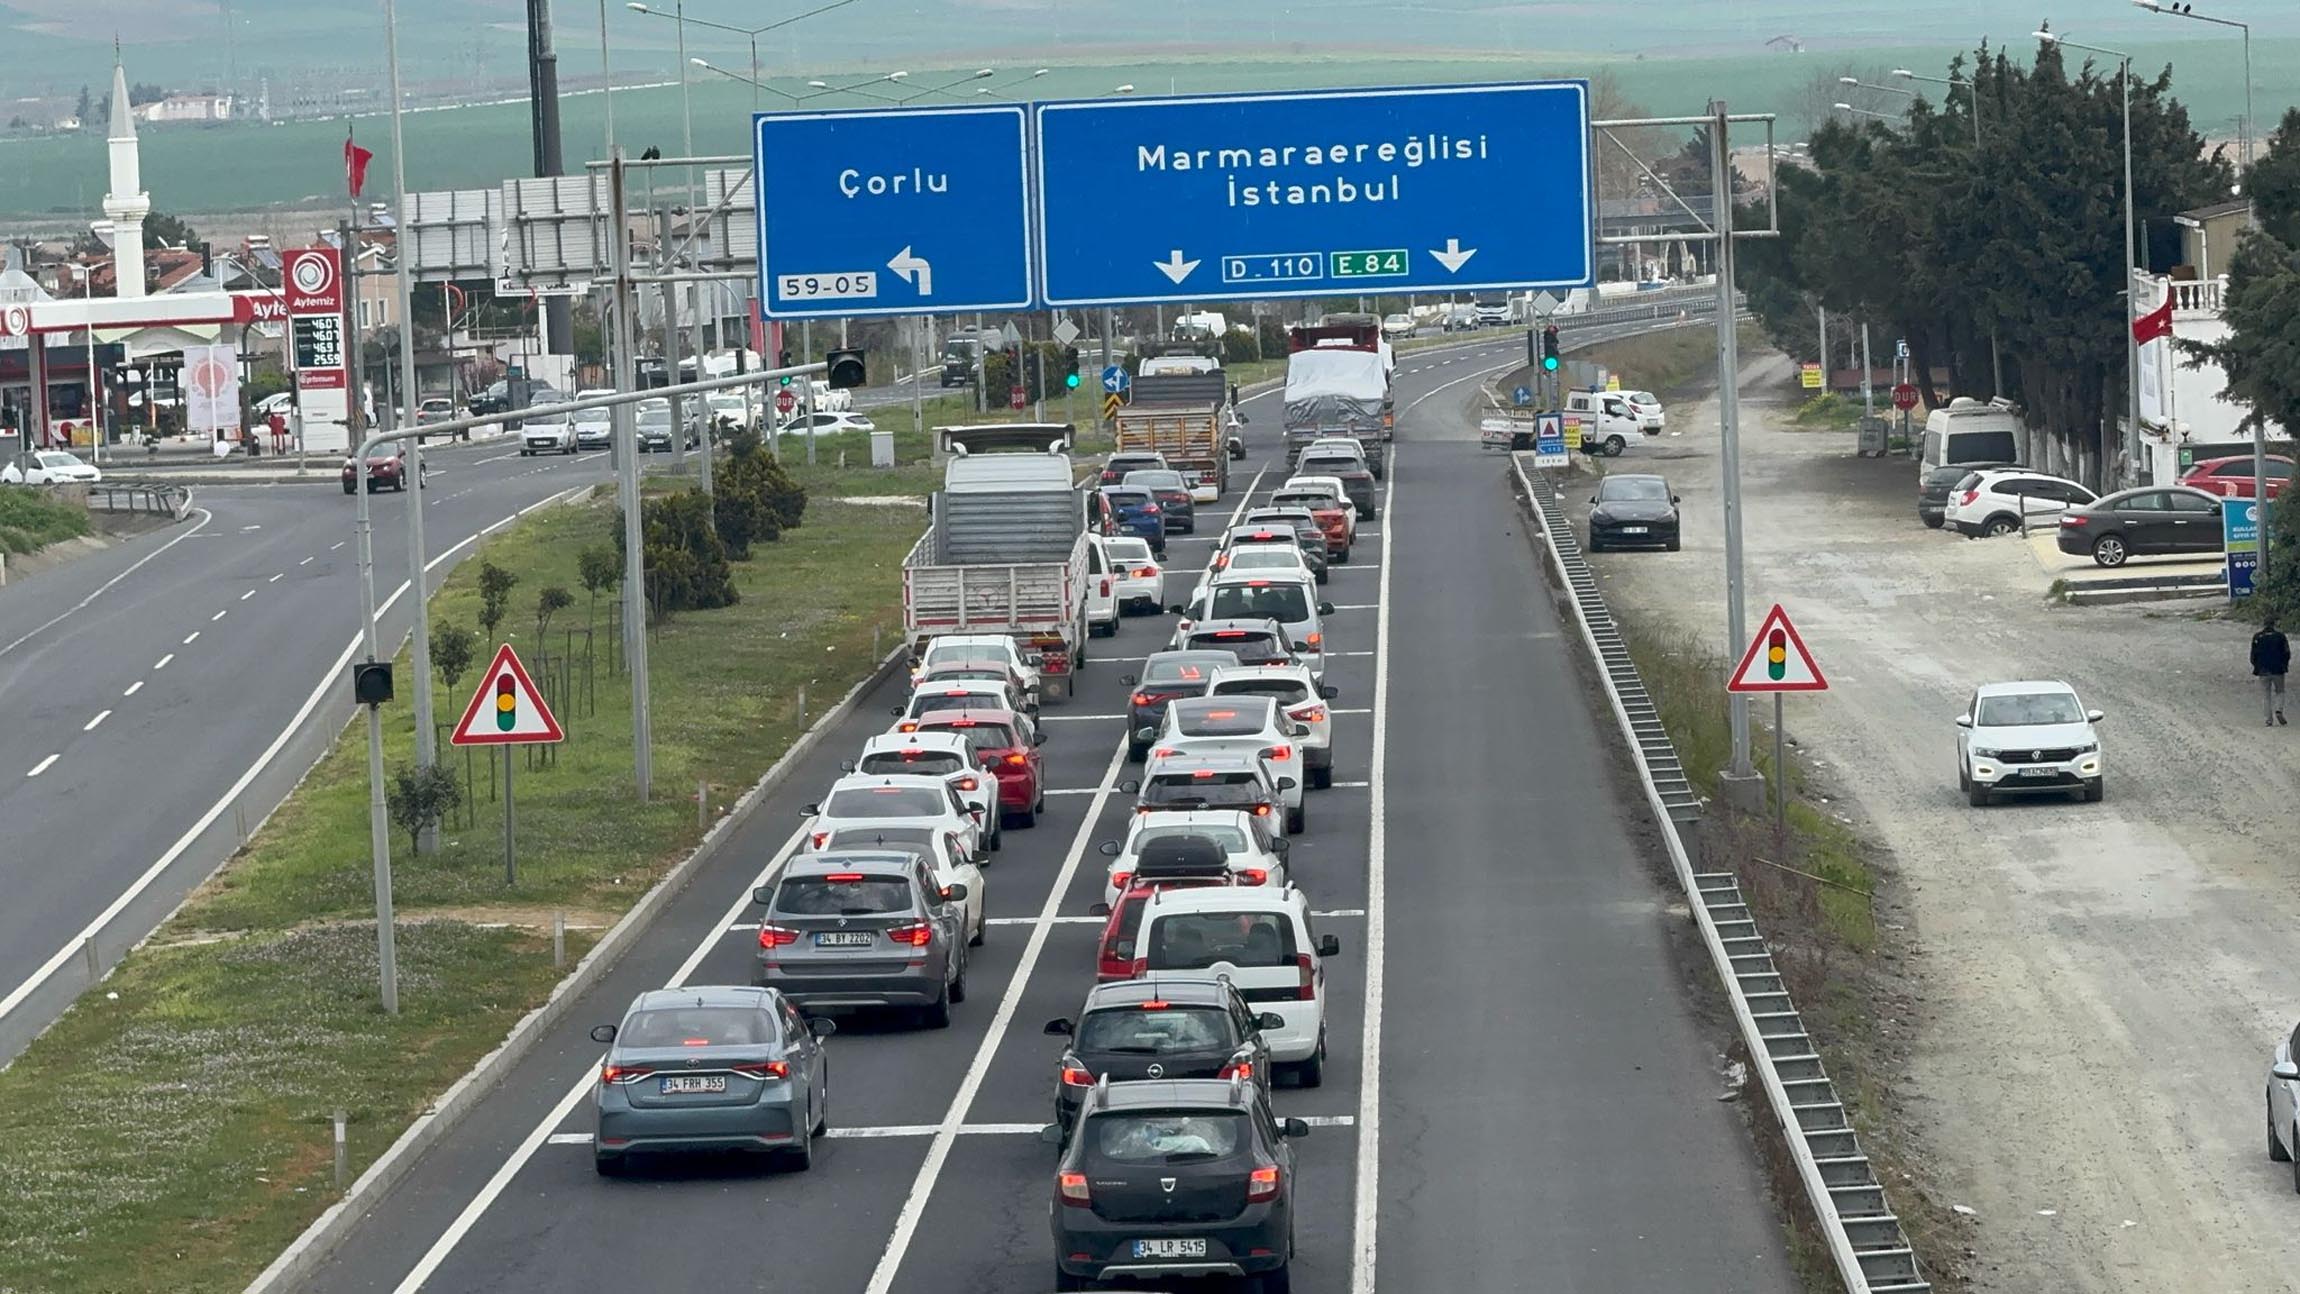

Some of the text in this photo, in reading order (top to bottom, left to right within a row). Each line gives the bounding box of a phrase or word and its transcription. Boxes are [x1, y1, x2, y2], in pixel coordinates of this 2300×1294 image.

[1138, 134, 1487, 171] Marmaraereğlisi
[839, 167, 948, 199] Çorlu
[1228, 174, 1399, 207] İstanbul
[786, 276, 869, 296] 59-05
[253, 301, 288, 319] Ayte
[293, 296, 335, 309] Aytemiz
[776, 396, 793, 407] DUR
[1894, 391, 1917, 402] DUR
[667, 1077, 724, 1089] 34 FRH 355
[1140, 1240, 1205, 1253] 34 LR 5415
